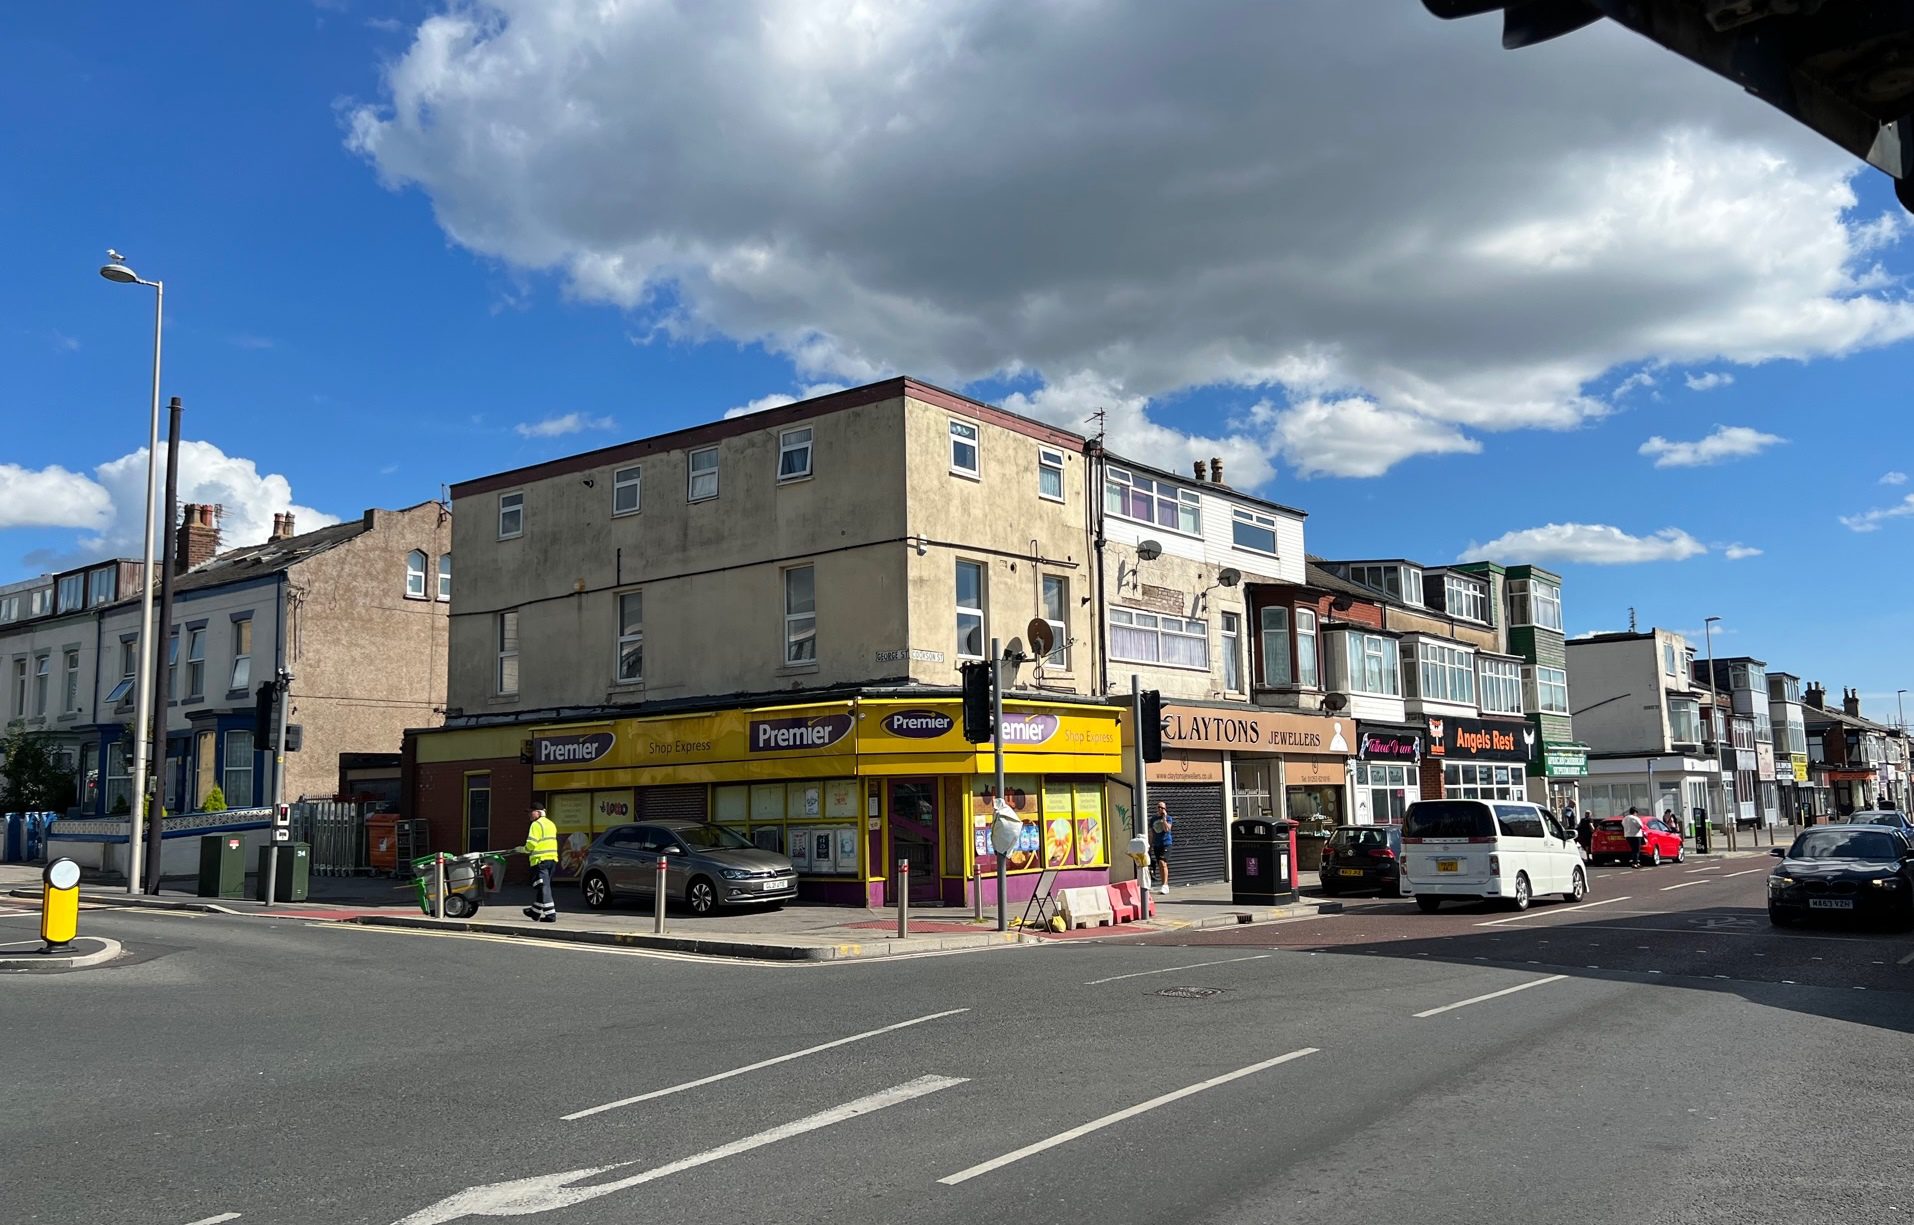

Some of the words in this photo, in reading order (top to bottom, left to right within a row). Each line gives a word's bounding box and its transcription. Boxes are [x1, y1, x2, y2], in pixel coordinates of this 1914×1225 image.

[877, 651, 898, 661] GEORGE
[901, 650, 908, 658] ST
[893, 715, 950, 730] Premier
[1001, 721, 1045, 741] emier
[1163, 715, 1260, 744] CLAYTONS
[1268, 731, 1321, 747] JEWELLERS
[759, 724, 832, 748] Premier
[1065, 729, 1084, 744] Shop
[1086, 731, 1114, 745] Express
[1456, 727, 1491, 753] Angels
[1492, 730, 1515, 751] Rest
[541, 740, 599, 761] Premier
[650, 742, 673, 756] Shop
[675, 740, 711, 755] Express
